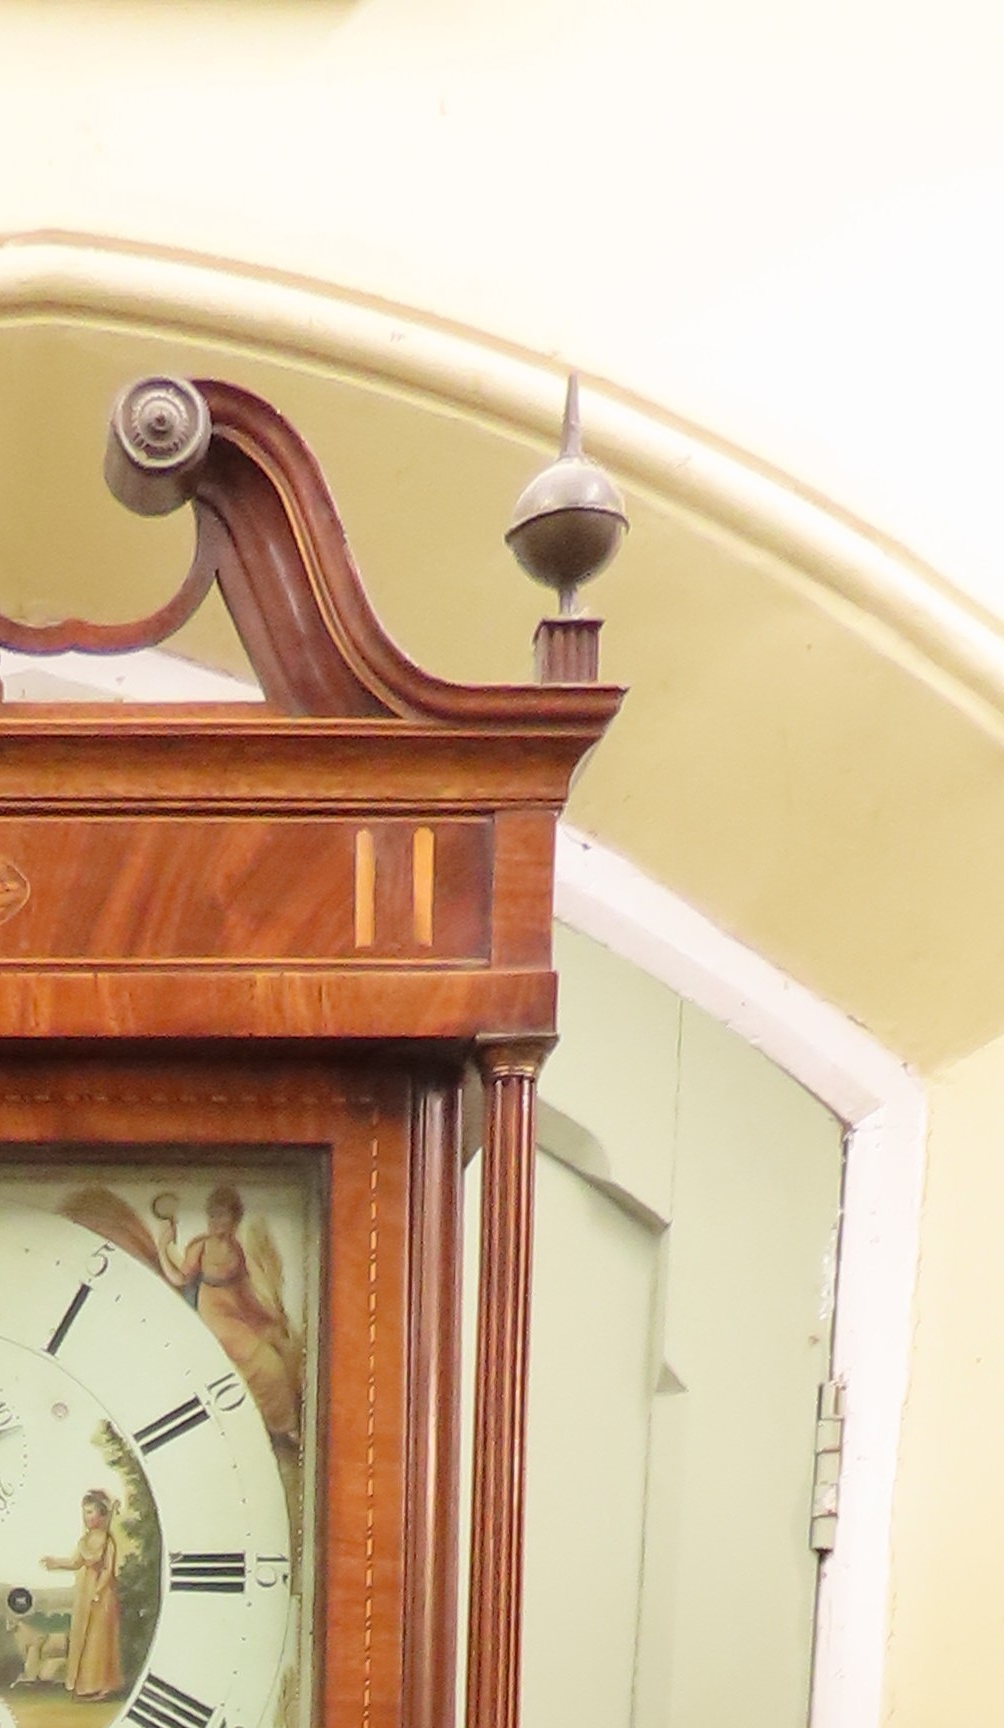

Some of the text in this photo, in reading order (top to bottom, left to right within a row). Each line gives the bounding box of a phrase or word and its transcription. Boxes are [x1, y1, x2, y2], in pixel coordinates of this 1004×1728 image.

[86, 1242, 116, 1277] 5
[205, 1372, 246, 1412] 10
[256, 1553, 289, 1588] 15
